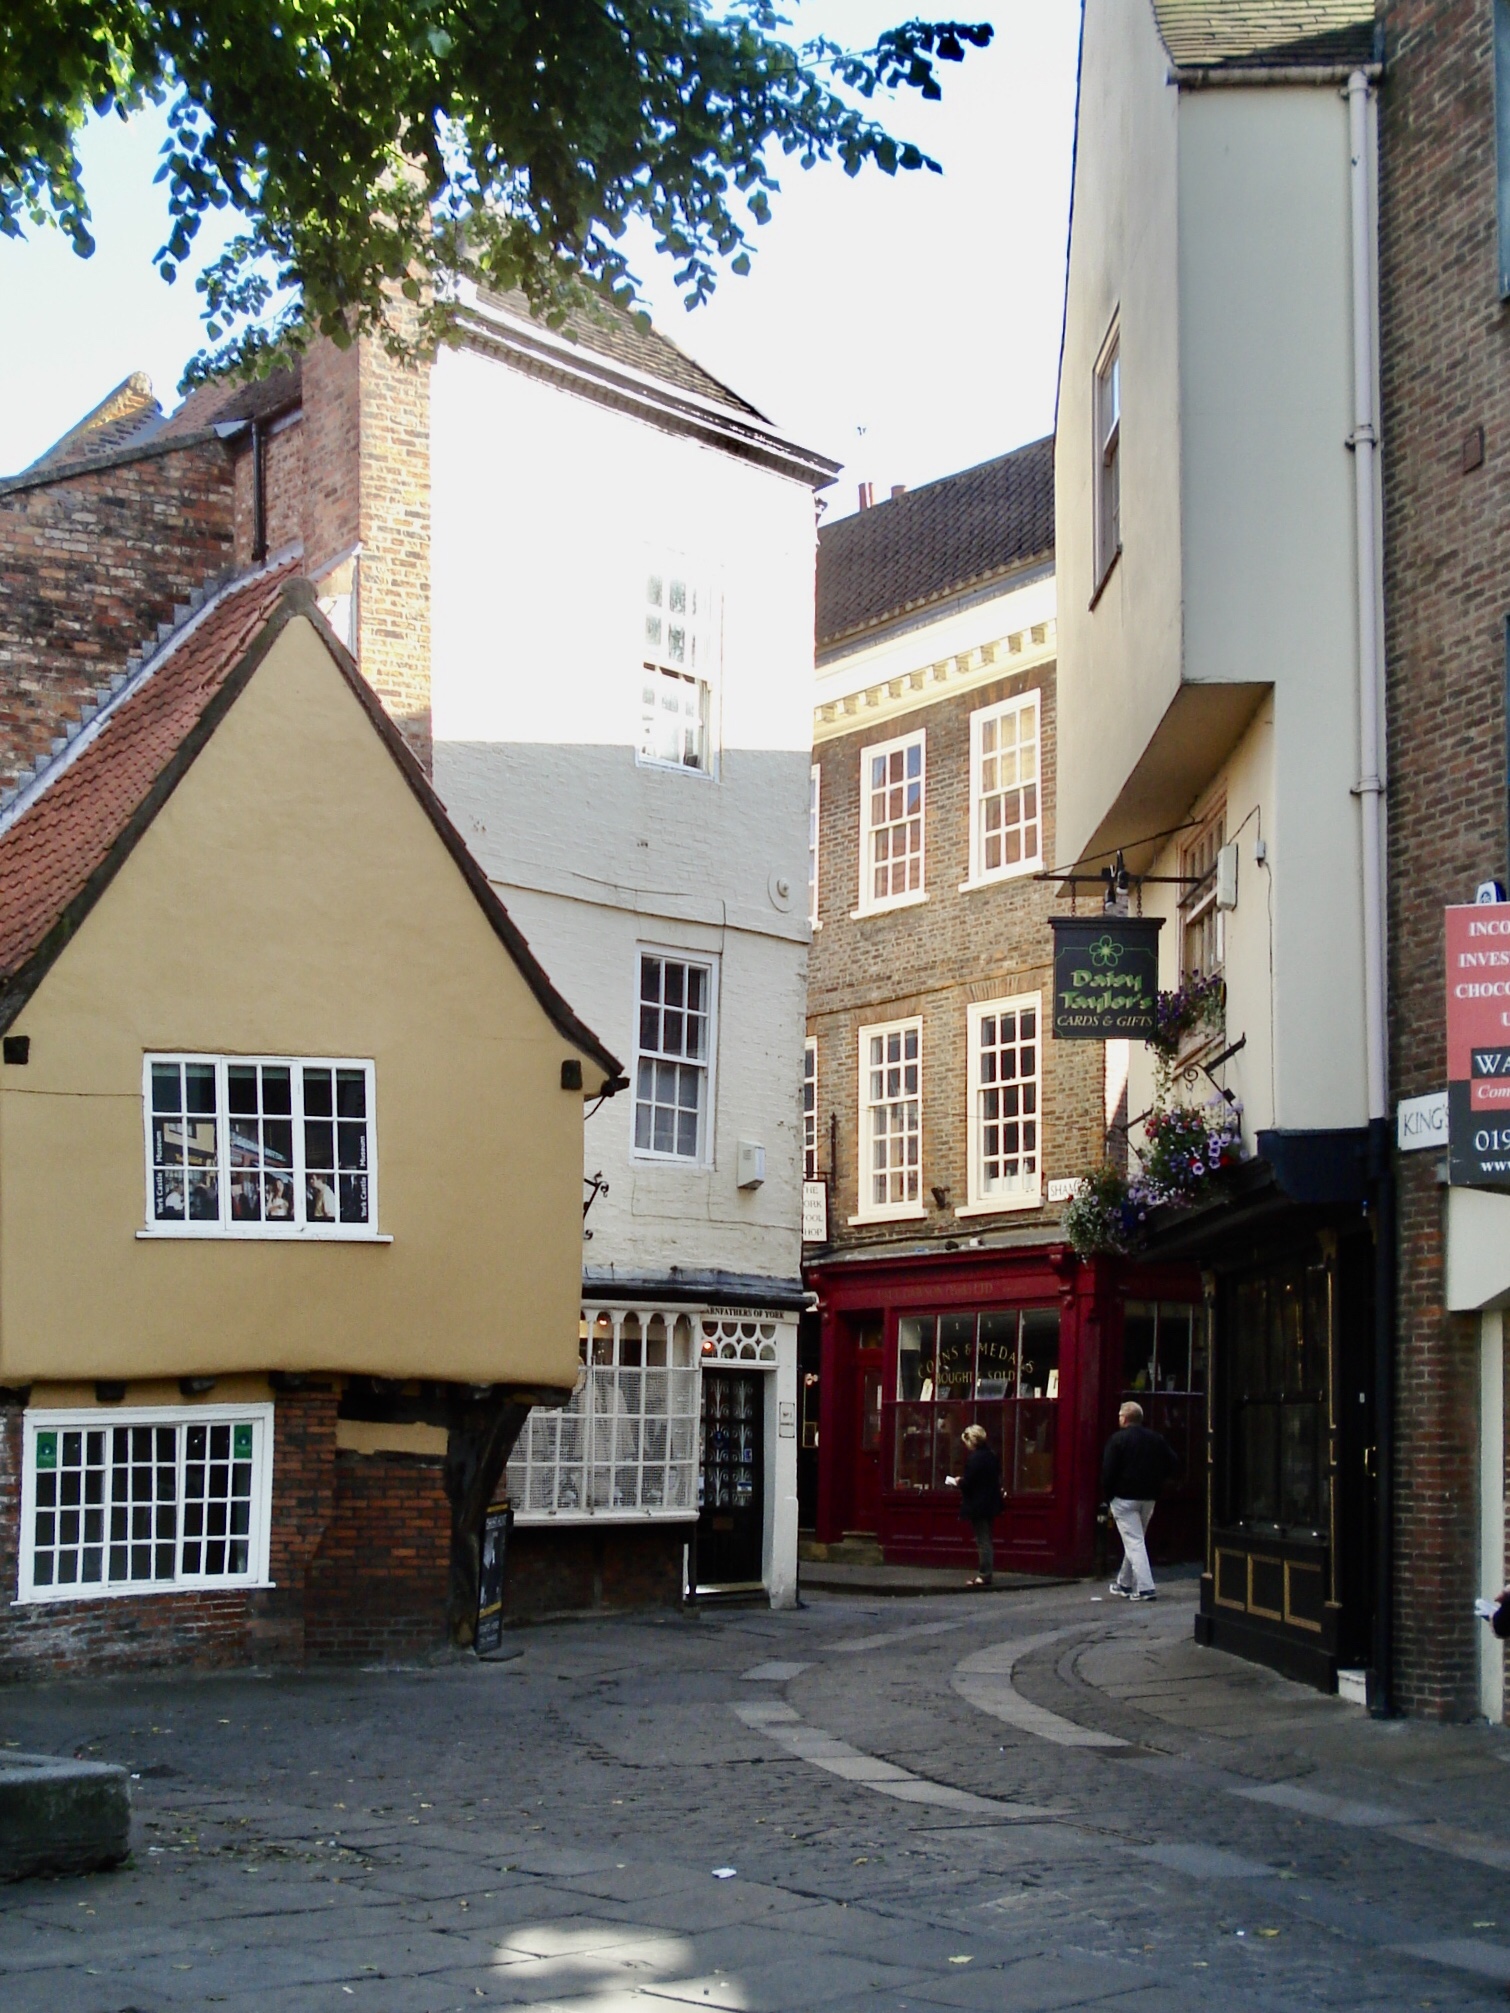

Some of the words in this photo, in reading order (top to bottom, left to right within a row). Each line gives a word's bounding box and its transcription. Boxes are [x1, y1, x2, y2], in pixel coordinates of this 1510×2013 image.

[1070, 970, 1142, 991] Daisy
[1059, 990, 1153, 1013] Taylor's
[1057, 1015, 1098, 1027] CARDS
[1102, 1015, 1112, 1027] &
[1117, 1015, 1153, 1027] GIFTS
[1481, 1160, 1510, 1171] ww
[803, 1200, 822, 1208] ORK
[803, 1214, 823, 1222] OOL
[803, 1228, 823, 1236] HOP
[764, 1310, 784, 1319] YORK
